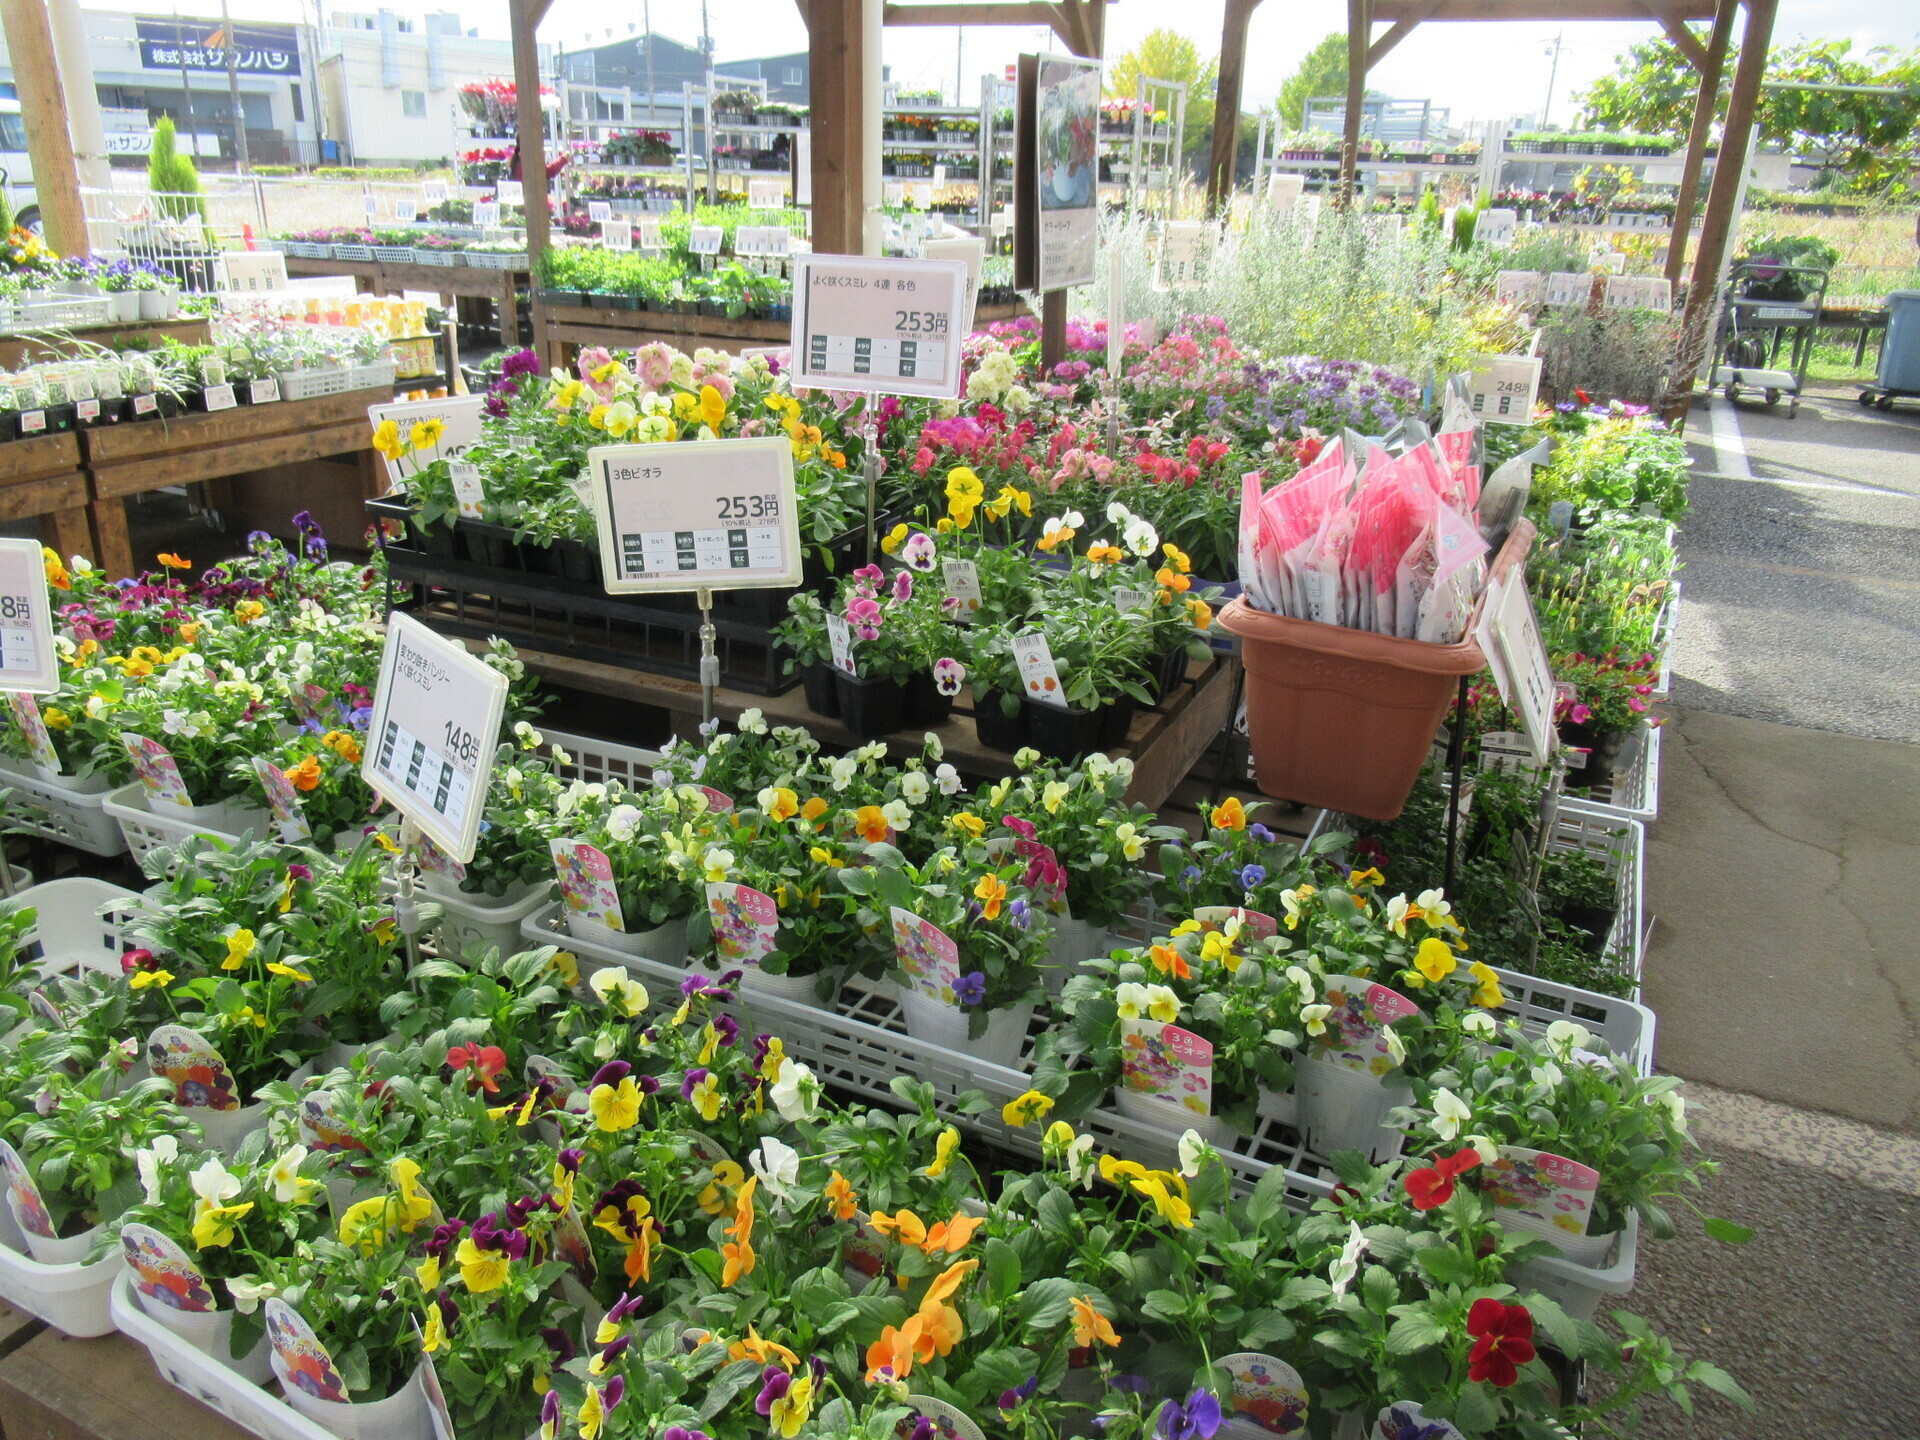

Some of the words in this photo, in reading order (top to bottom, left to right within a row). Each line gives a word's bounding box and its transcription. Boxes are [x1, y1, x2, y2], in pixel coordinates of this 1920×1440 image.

[813, 275, 868, 289] よく咲くスミレ
[874, 279, 891, 291] 4連
[896, 280, 916, 292] 各色
[894, 310, 948, 333] 253円
[613, 467, 662, 480] 3色ビオラ
[716, 496, 779, 519] 253円
[401, 643, 450, 683] 変わり咲きパンジー
[397, 662, 432, 691] よく咲くスミレ
[445, 720, 480, 768] 148円
[582, 850, 598, 861] 3色
[584, 860, 608, 873] ビオラ
[743, 892, 760, 903] 3色
[745, 903, 772, 918] ビオラ
[928, 930, 942, 942] 3色
[928, 938, 954, 957] ビオラ
[1377, 992, 1398, 1008] 3色
[1172, 1032, 1194, 1046] 3色
[1172, 1043, 1207, 1060] ビオラ
[1549, 1160, 1574, 1172] 3色
[1546, 1168, 1589, 1185] ビオラ
